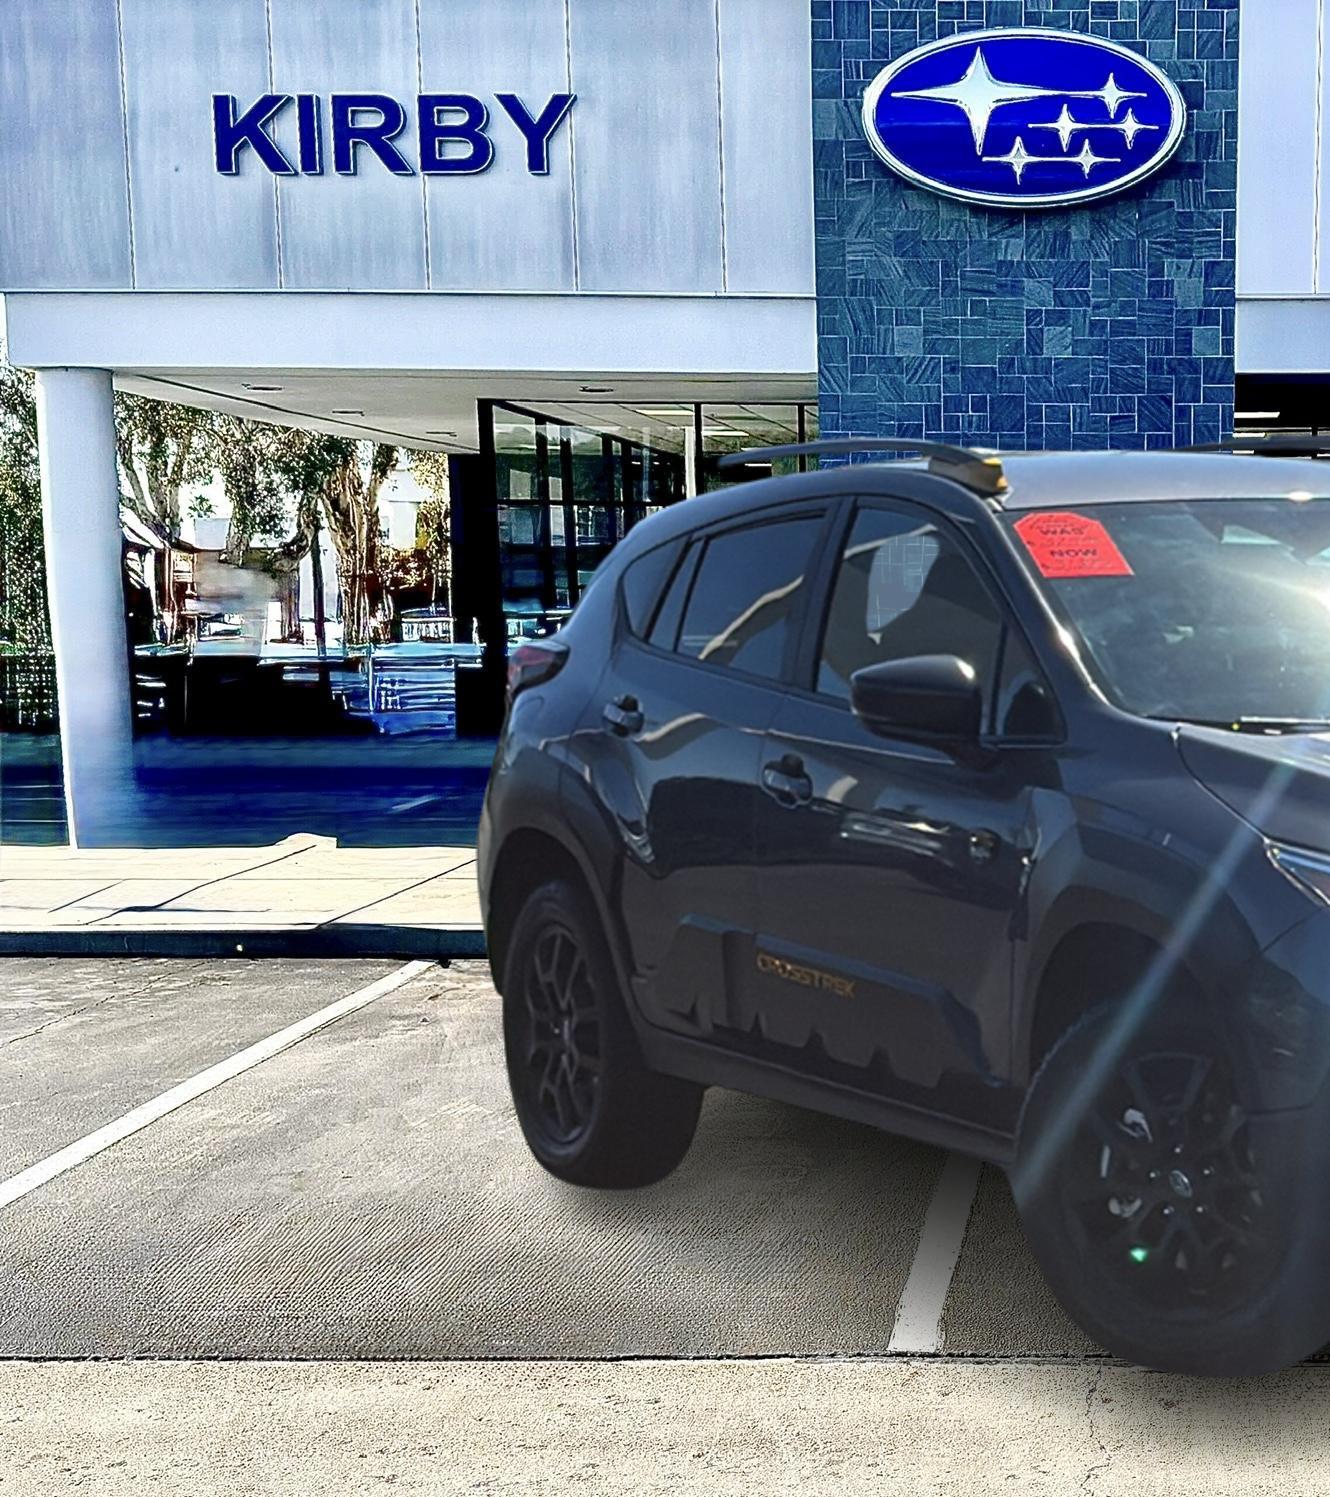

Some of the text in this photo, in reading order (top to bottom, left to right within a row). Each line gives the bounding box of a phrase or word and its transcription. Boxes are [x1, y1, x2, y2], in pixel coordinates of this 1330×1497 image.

[212, 93, 577, 176] KIRBY
[1040, 528, 1085, 536] WAS
[1050, 548, 1097, 558] NOW
[757, 953, 856, 999] CROSSTREK
